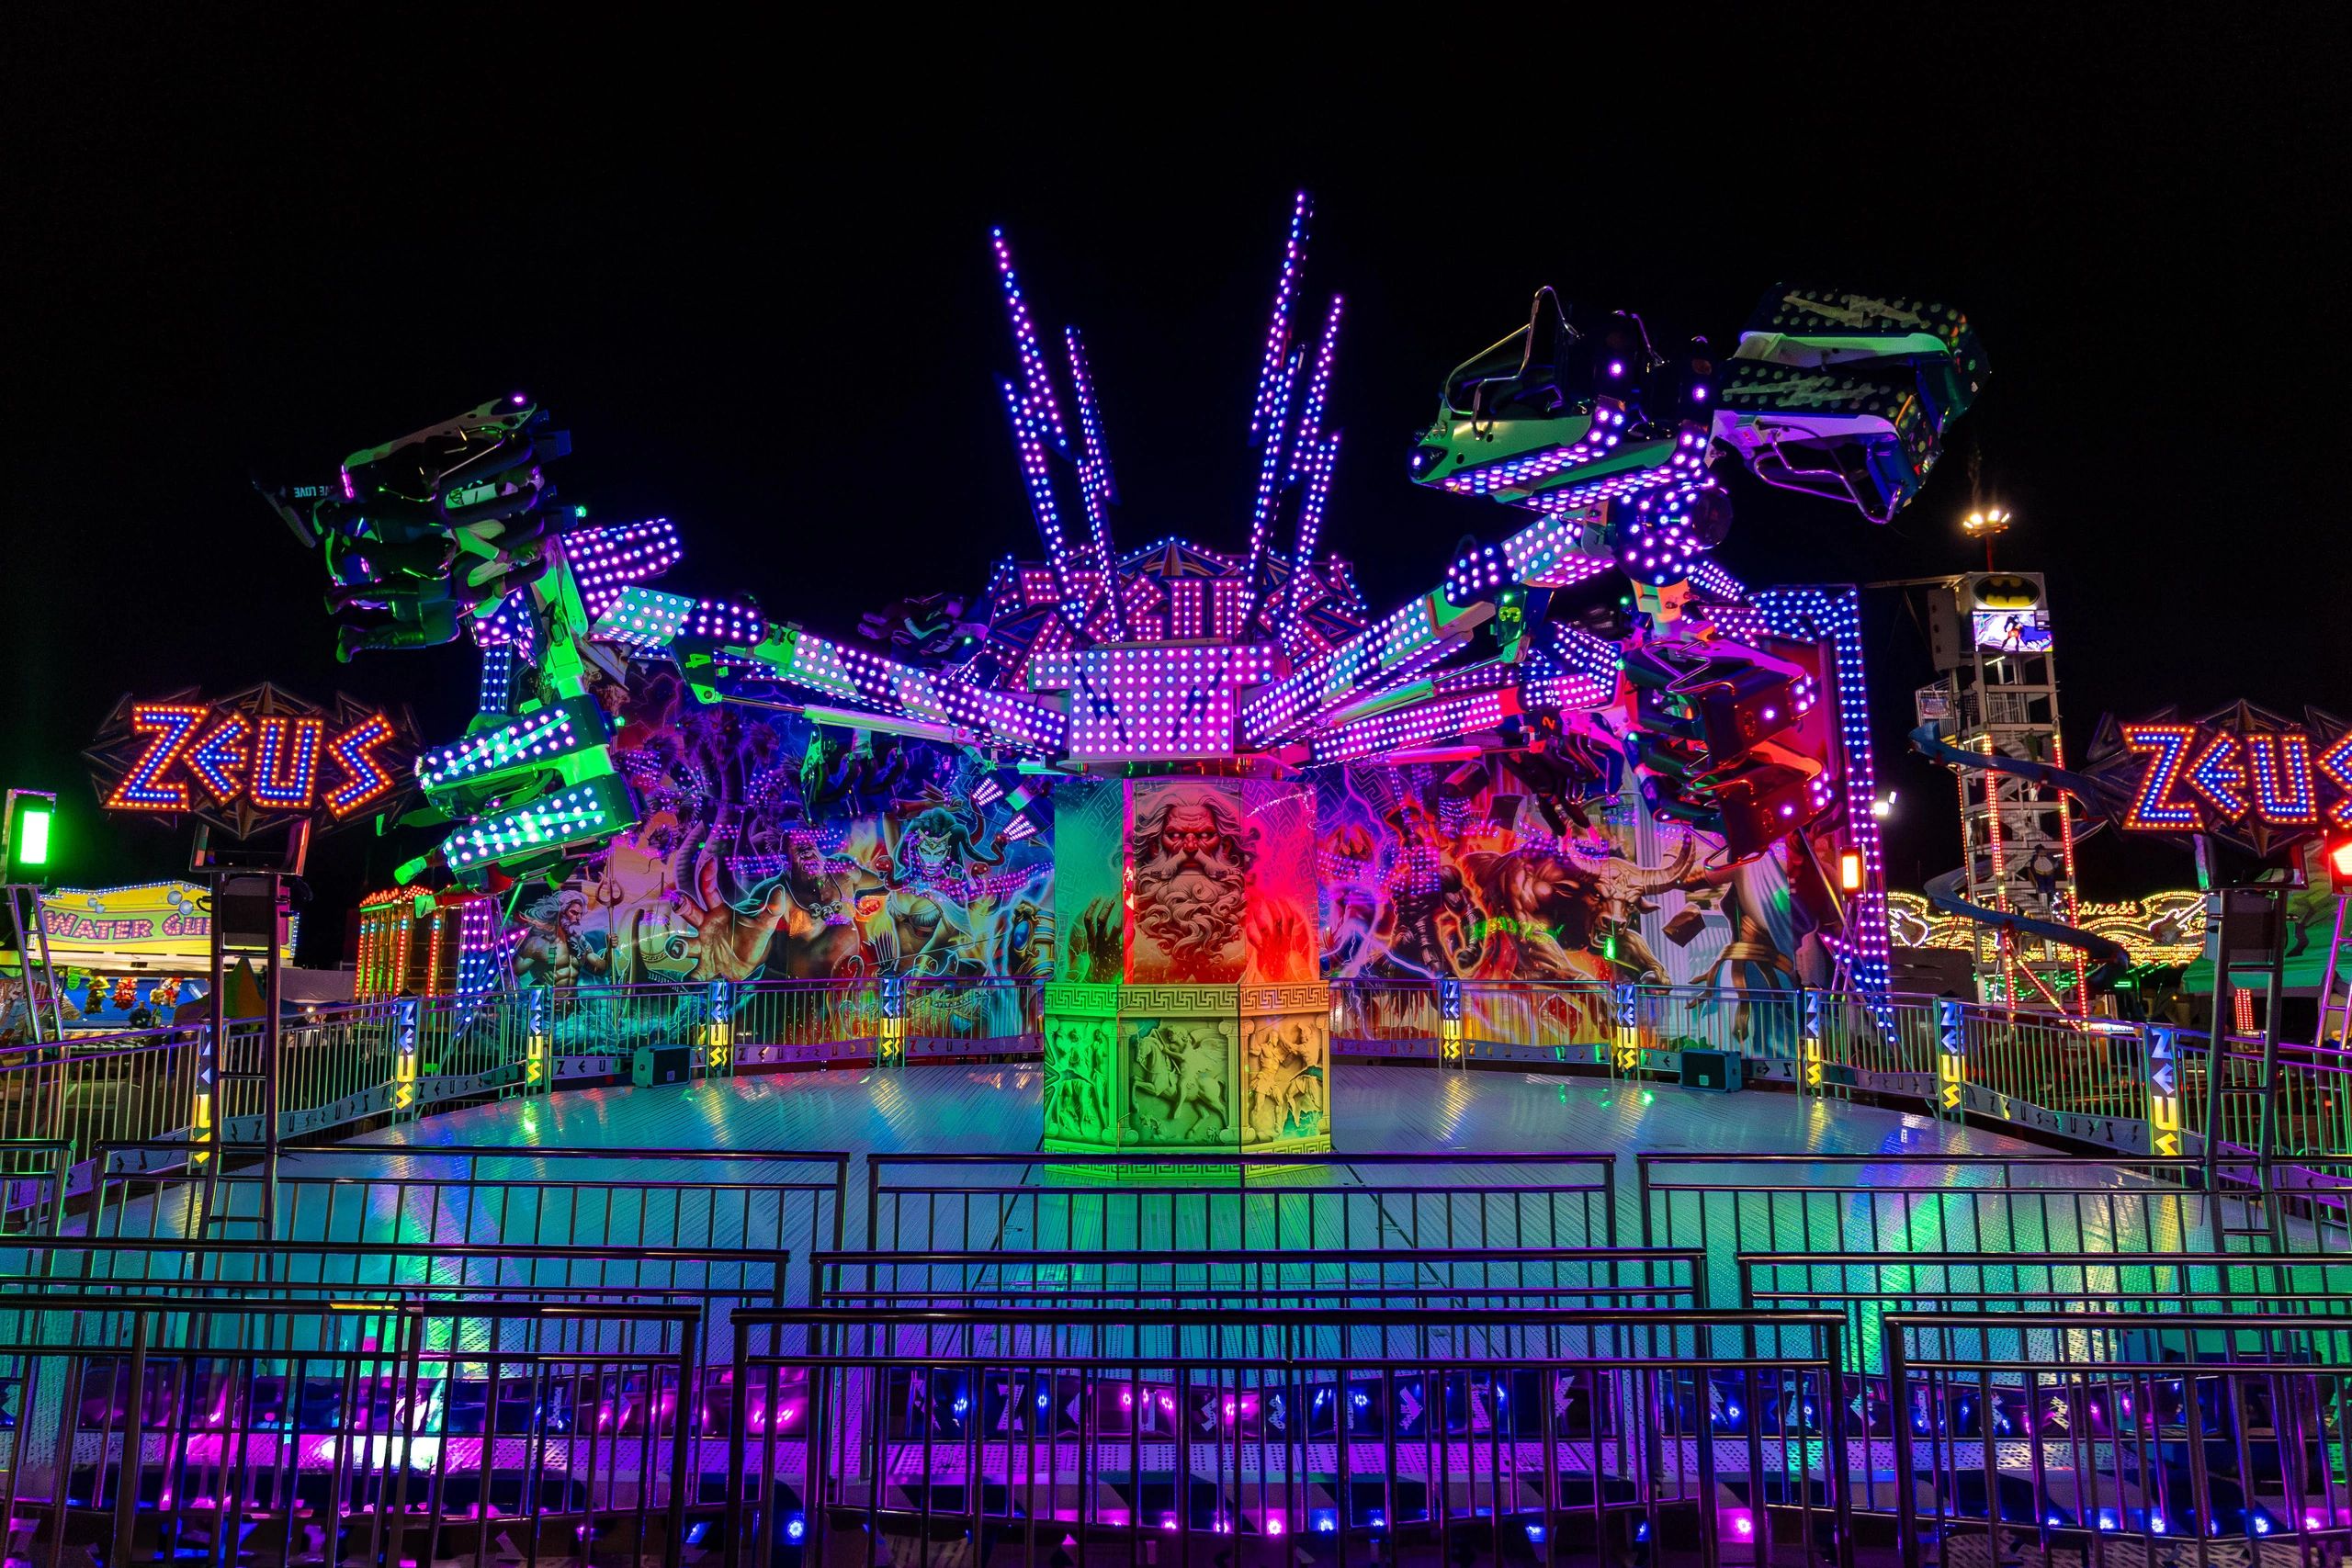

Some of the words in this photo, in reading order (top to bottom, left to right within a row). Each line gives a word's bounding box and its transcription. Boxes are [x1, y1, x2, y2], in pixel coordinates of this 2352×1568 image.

[1498, 606, 1521, 623] 3
[685, 654, 711, 669] 4
[103, 703, 395, 818] ZEUS
[1543, 716, 1555, 730] 2
[2120, 722, 2352, 831] ZEUS
[45, 909, 153, 940] WATER
[396, 1000, 416, 1110] ZEUS
[527, 989, 543, 1084] ZEUS
[709, 982, 723, 1067] ZEUS
[881, 979, 895, 1057] ZEUS
[1449, 980, 1462, 1059] ZEUS
[1623, 985, 1636, 1069] ZEUS
[1806, 992, 1822, 1085] ZEUS
[1940, 1001, 1961, 1109] ZEUS
[254, 1113, 311, 1141] ZUS
[417, 1079, 469, 1100] ZEUS
